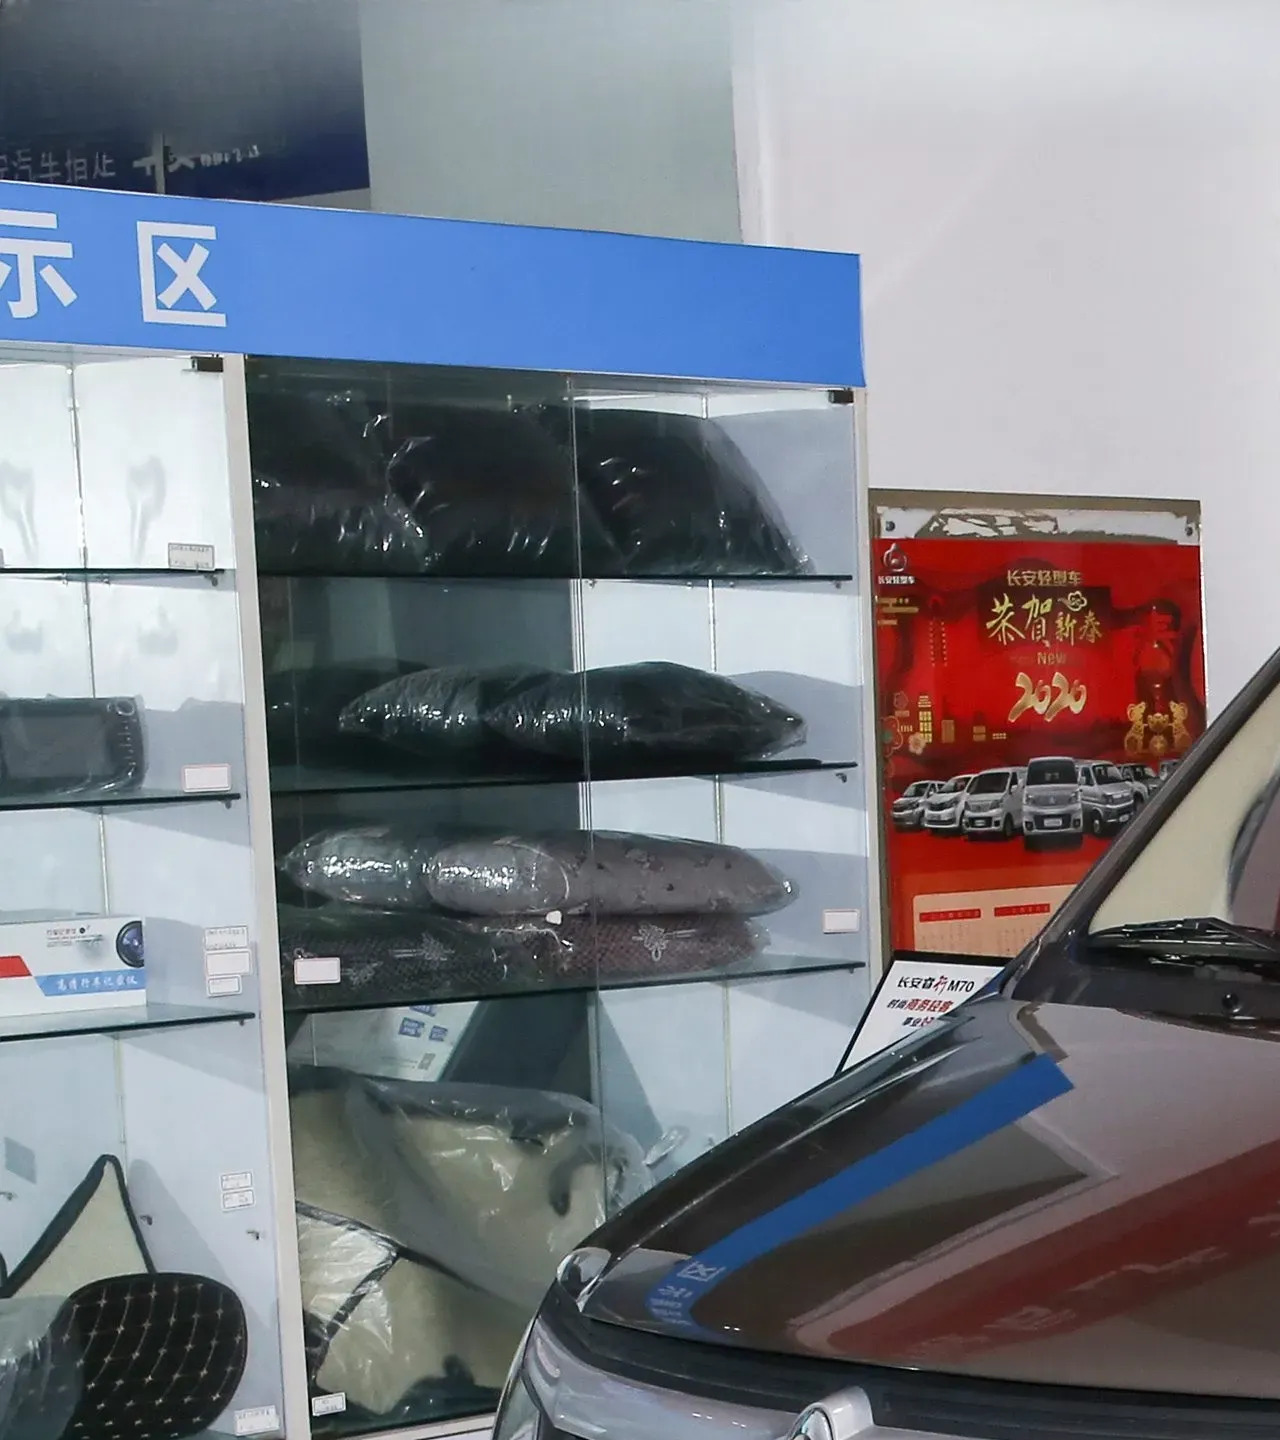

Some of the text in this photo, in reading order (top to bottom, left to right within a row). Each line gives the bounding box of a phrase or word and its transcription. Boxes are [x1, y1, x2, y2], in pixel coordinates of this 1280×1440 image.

[1007, 570, 1083, 587] 长安轻型车
[1008, 672, 1087, 722] 2020
